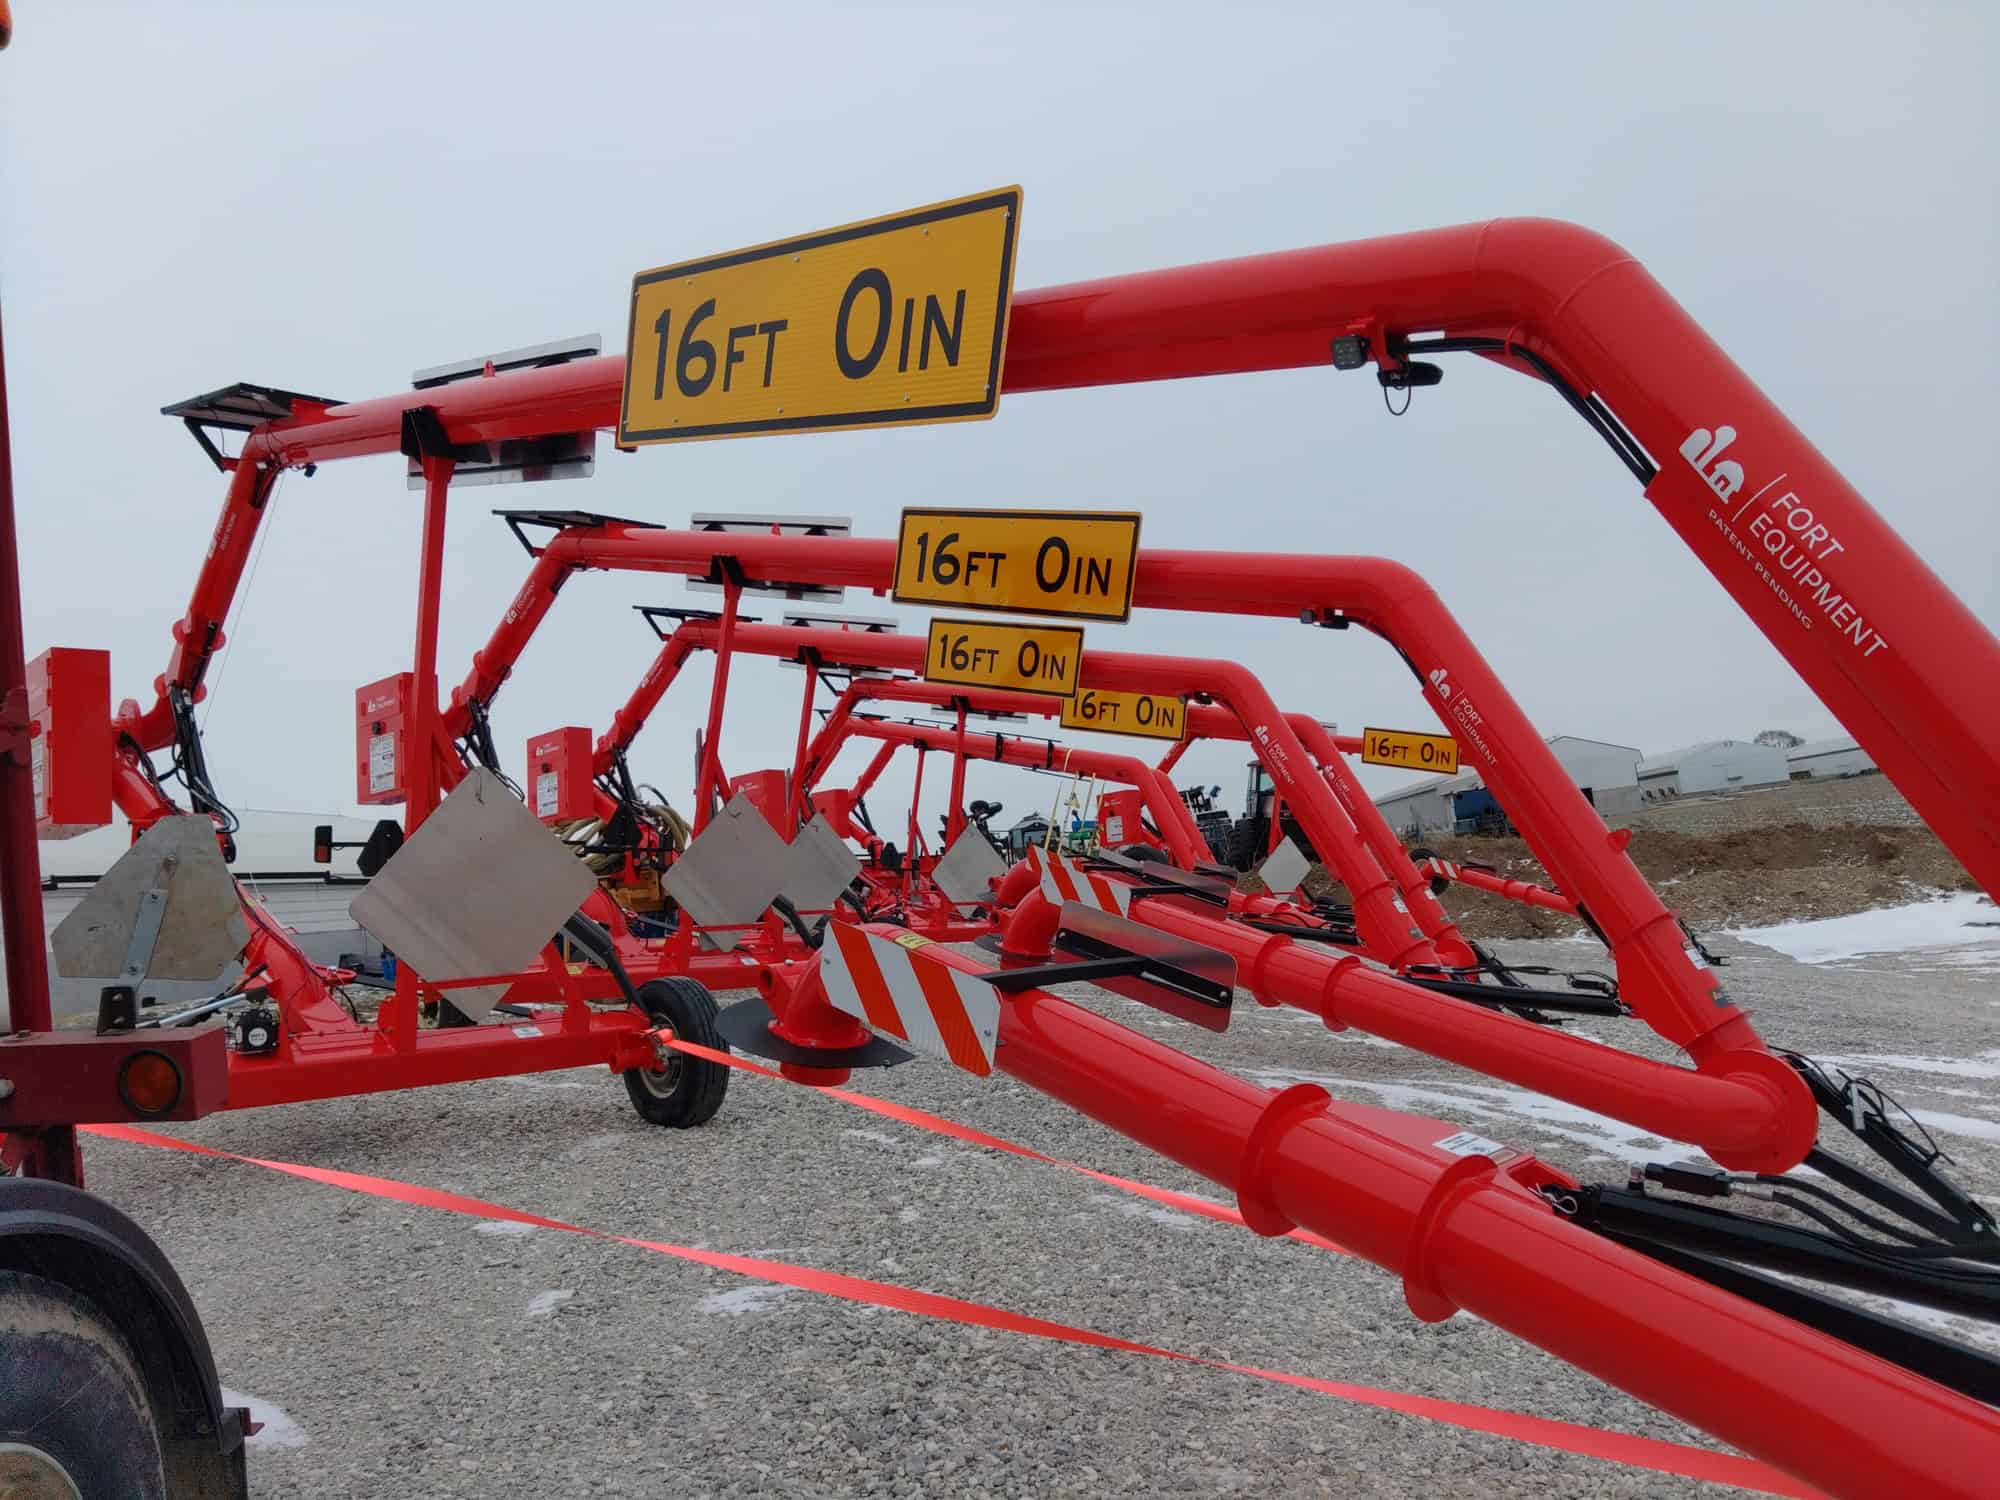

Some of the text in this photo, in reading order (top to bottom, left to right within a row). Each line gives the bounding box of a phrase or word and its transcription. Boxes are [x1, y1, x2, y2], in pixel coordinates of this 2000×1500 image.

[654, 268, 966, 400] 16FT 0IN
[1772, 491, 1845, 560] FORT
[917, 532, 1112, 596] 16FT 0IN
[1708, 508, 1813, 630] PATENT PENDING
[1749, 512, 1889, 657] EQUIPMENT
[940, 634, 1066, 681] 16FT 0IN
[1136, 696, 1175, 728] 0IN
[1453, 706, 1498, 766] EQUIPMENT
[1459, 697, 1484, 726] FORT
[1371, 736, 1451, 765] 16FT 0IN
